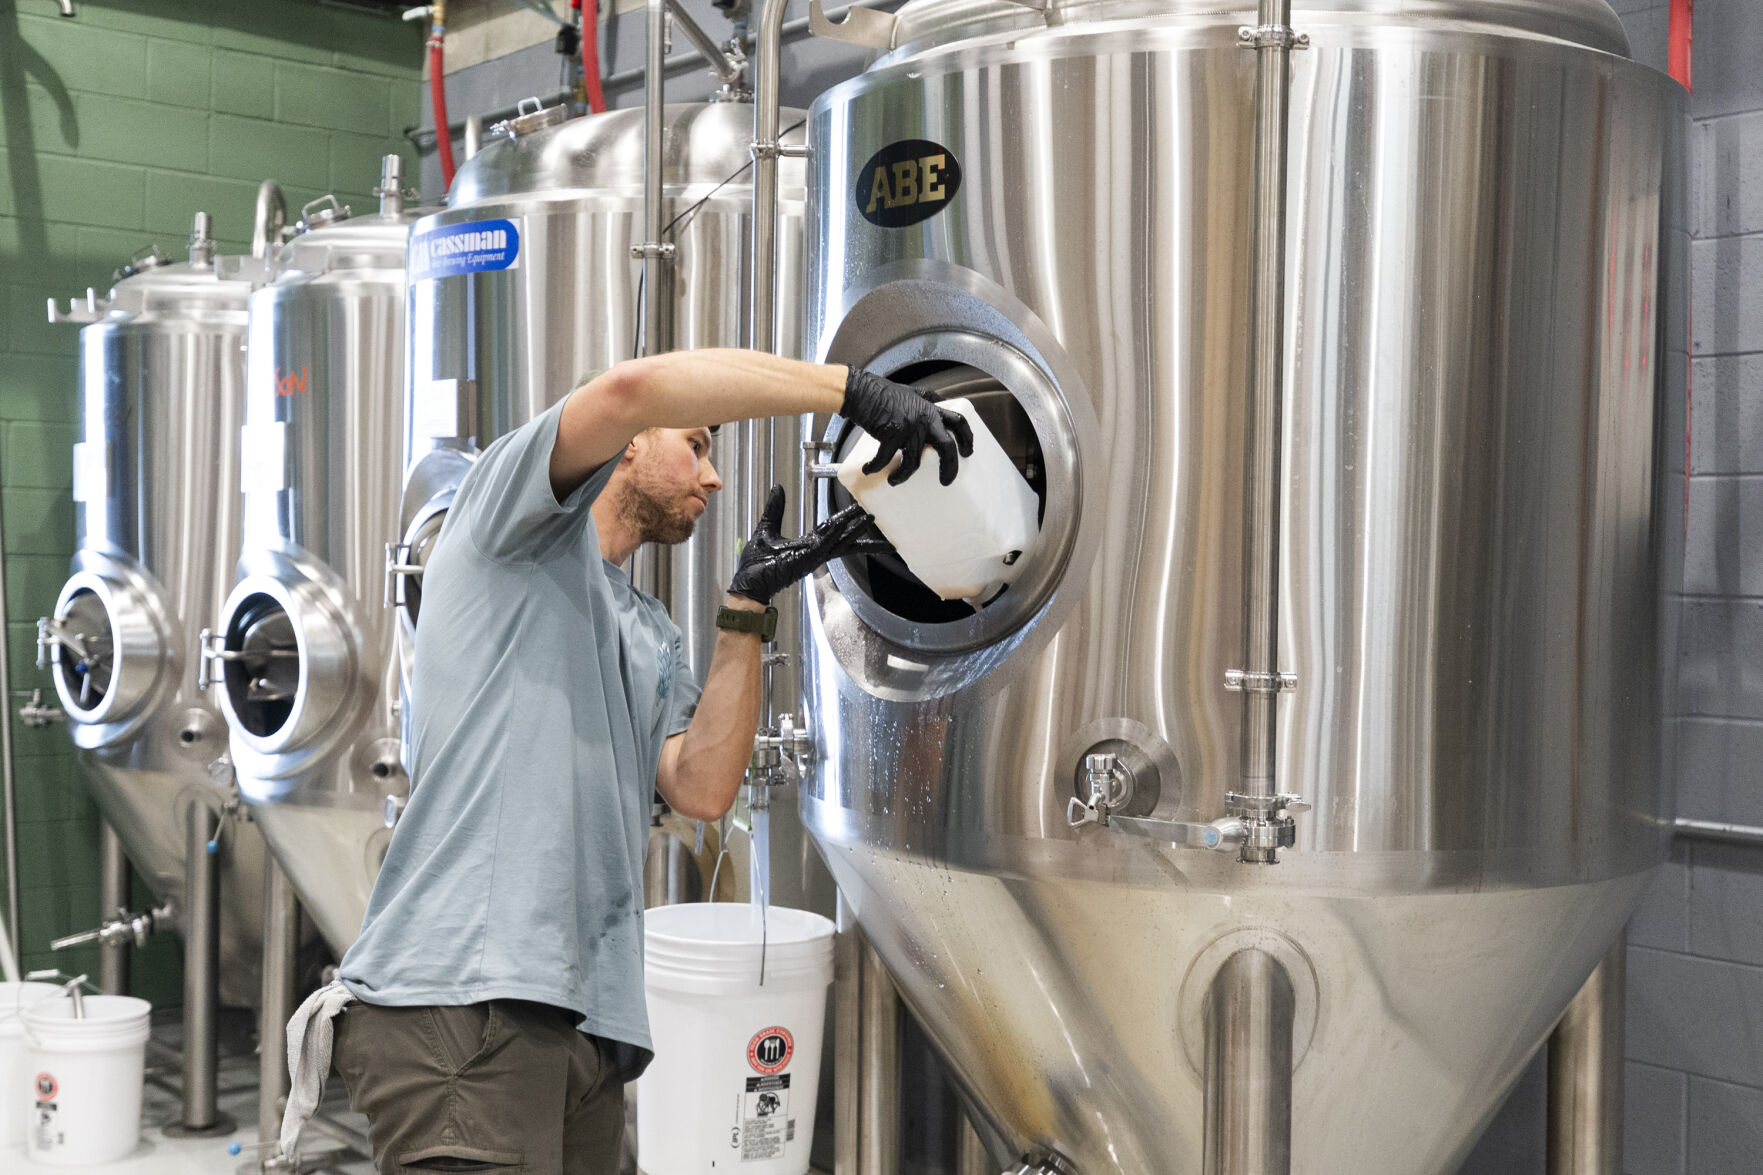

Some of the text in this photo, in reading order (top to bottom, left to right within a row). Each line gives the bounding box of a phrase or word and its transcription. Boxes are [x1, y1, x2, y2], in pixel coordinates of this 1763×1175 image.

[866, 154, 946, 213] ABE
[430, 230, 507, 257] cassman
[467, 251, 505, 266] Equipment
